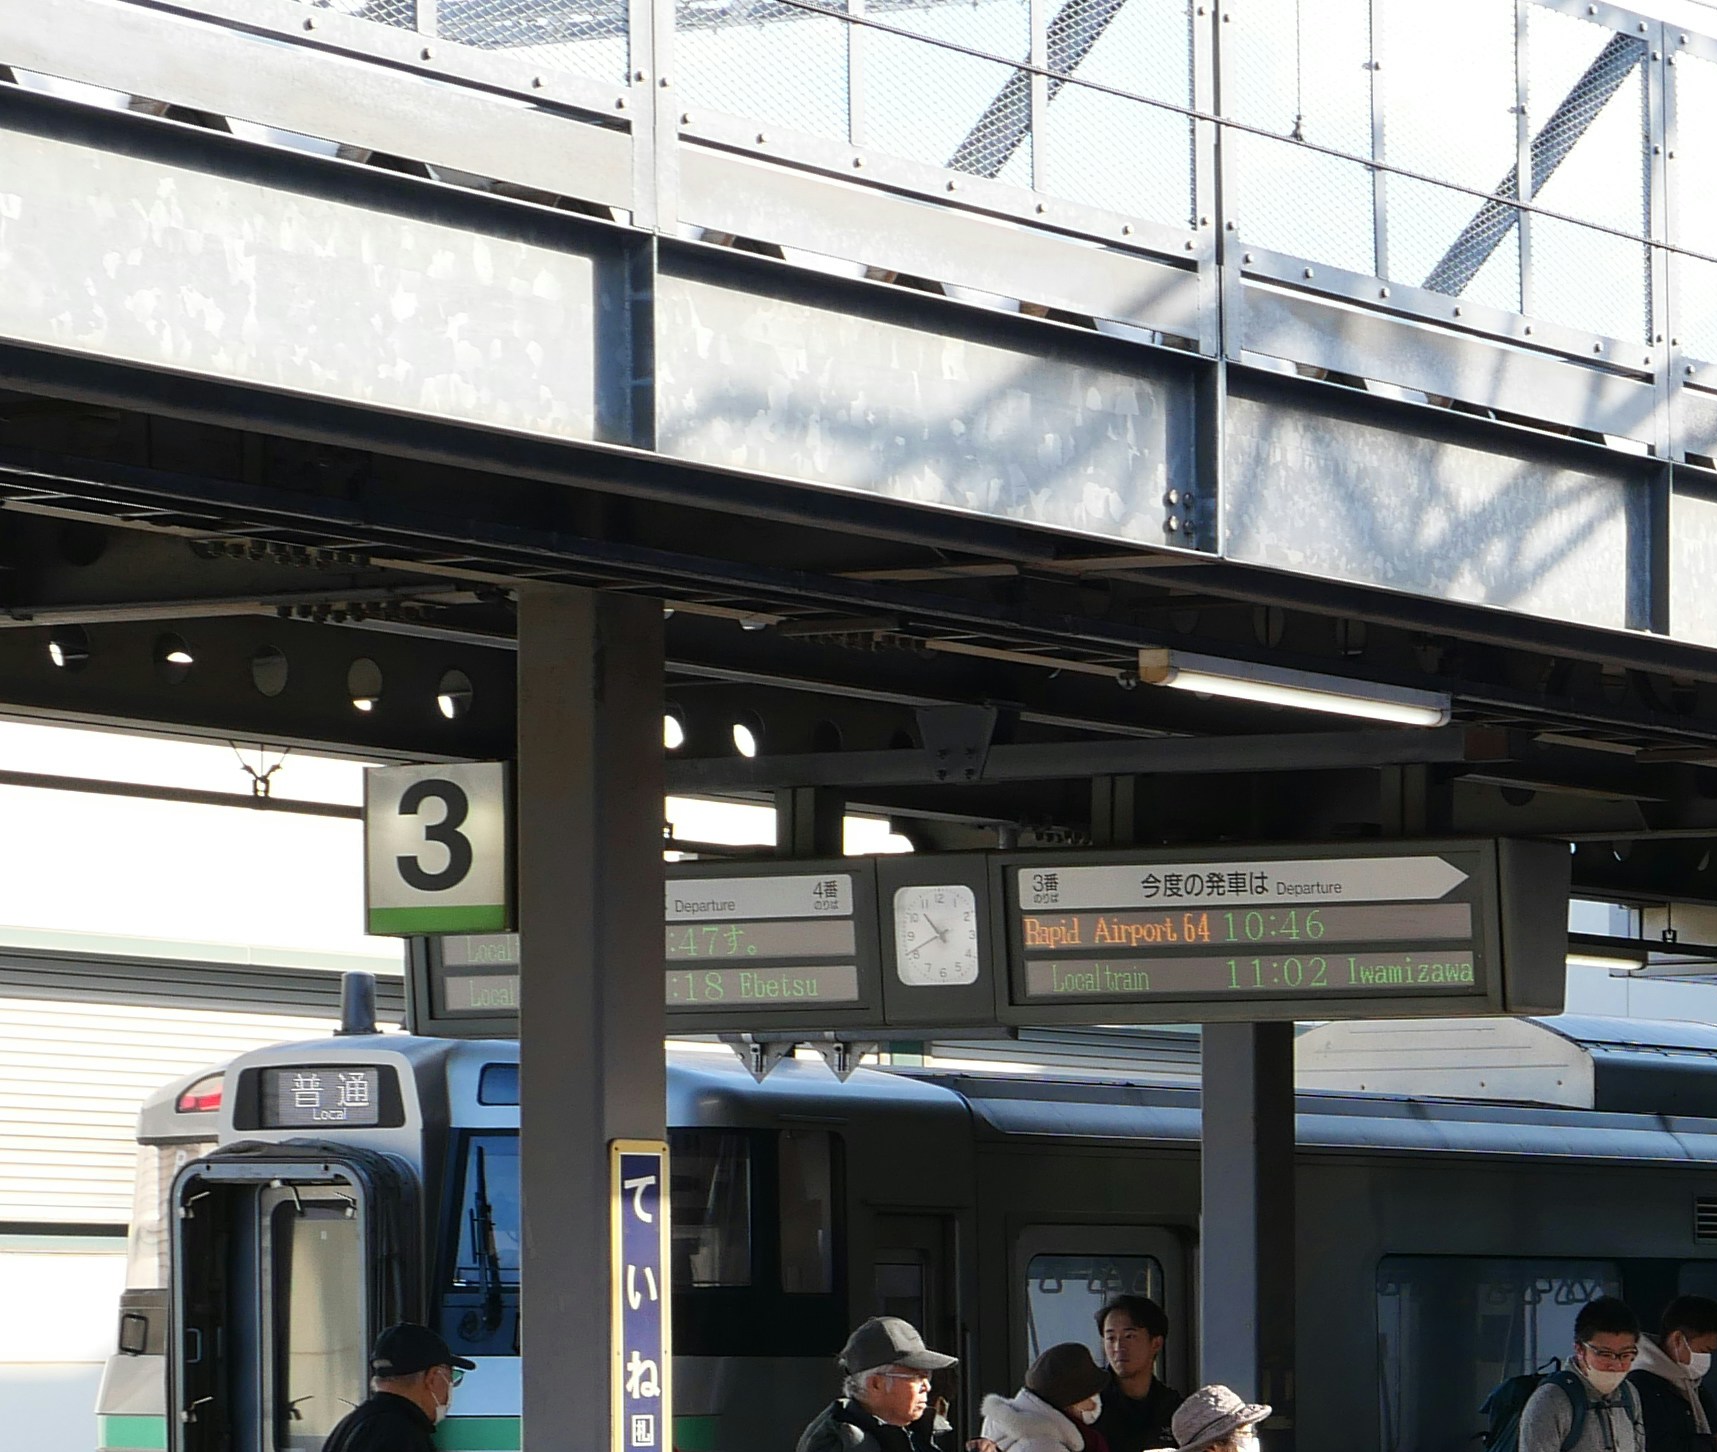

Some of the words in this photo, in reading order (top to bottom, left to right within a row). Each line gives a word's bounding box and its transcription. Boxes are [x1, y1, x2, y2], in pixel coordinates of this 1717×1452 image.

[396, 778, 473, 892] 3
[812, 879, 838, 899] 4番
[1032, 873, 1059, 893] 3番
[1141, 872, 1269, 898] 今度の発車は
[1276, 880, 1343, 898] Departure
[675, 898, 736, 915] Departure
[1023, 917, 1081, 948] Rapid
[1094, 916, 1177, 947] Airport
[1184, 912, 1211, 942] 64
[1223, 909, 1326, 942] 10:46
[470, 980, 514, 1007] Local
[740, 972, 818, 997] Ebetsu
[1227, 957, 1328, 990] 11:02
[1348, 956, 1475, 986] Iwamizawa
[290, 1072, 369, 1108] 普通
[312, 1107, 347, 1121] Local
[623, 1175, 661, 1400] ていね
